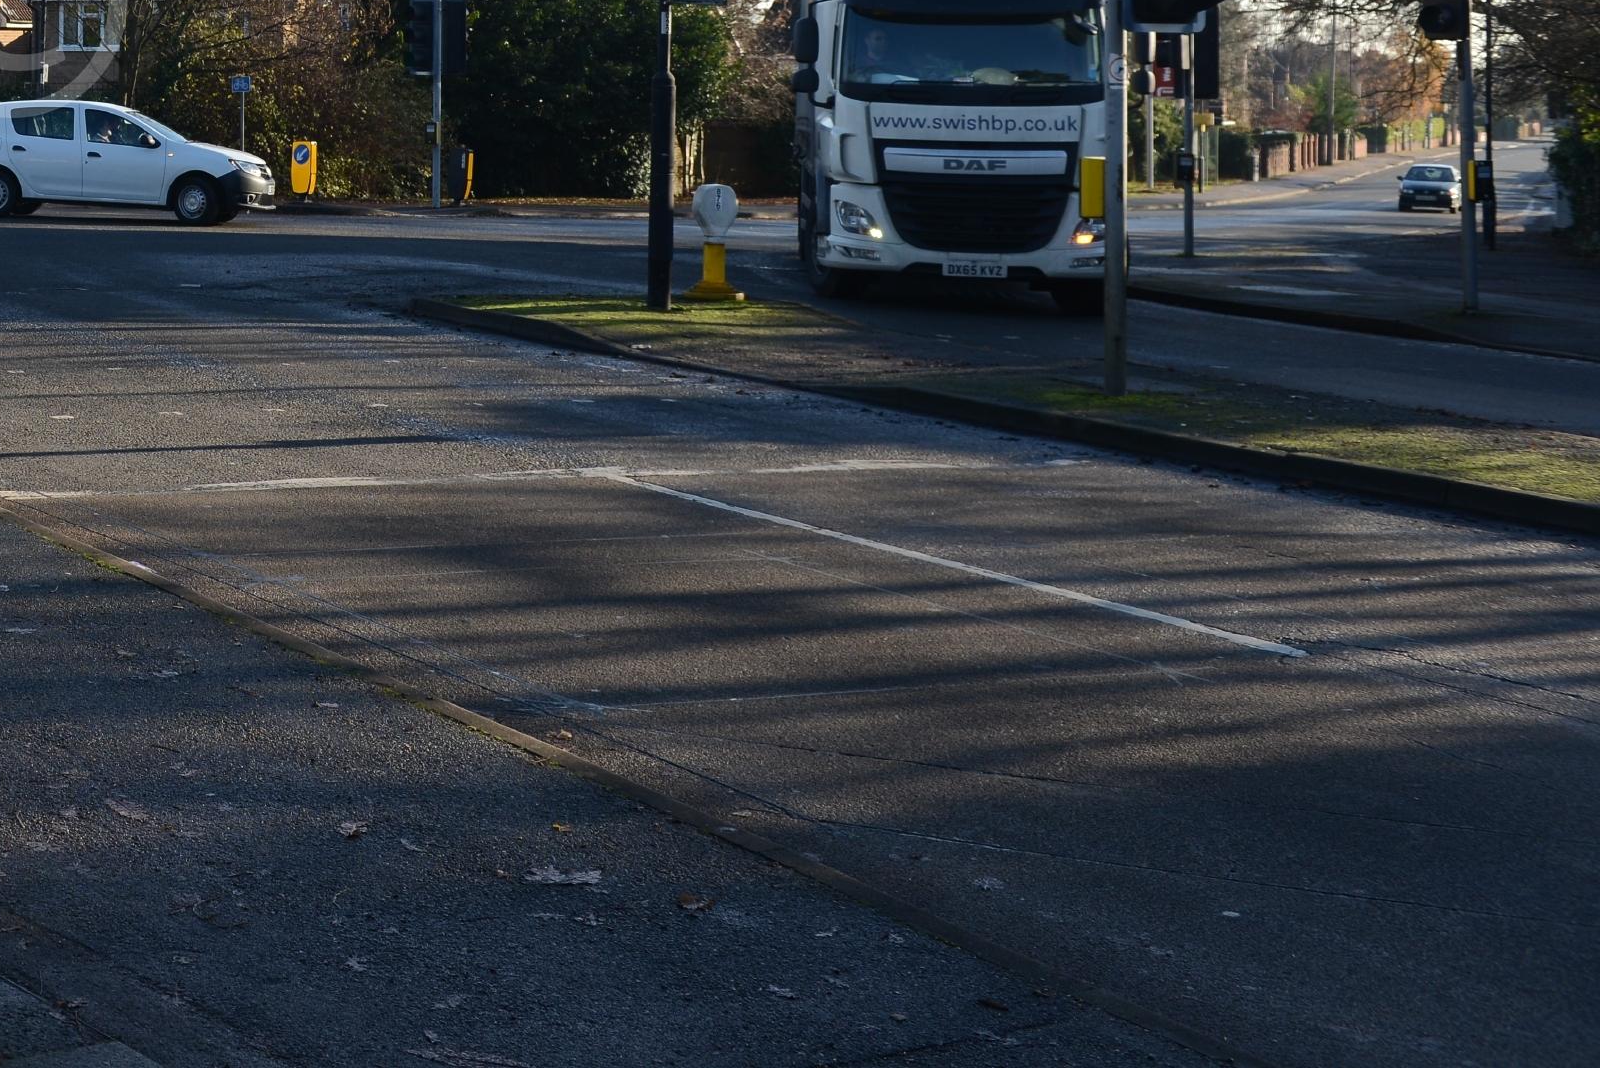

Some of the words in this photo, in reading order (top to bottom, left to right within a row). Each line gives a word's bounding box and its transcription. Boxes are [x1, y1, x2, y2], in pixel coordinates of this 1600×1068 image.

[873, 114, 1079, 134] www.swishbp.co.uk
[943, 158, 1008, 171] DAF
[947, 264, 978, 276] DX65
[980, 265, 1003, 277] KVZ
